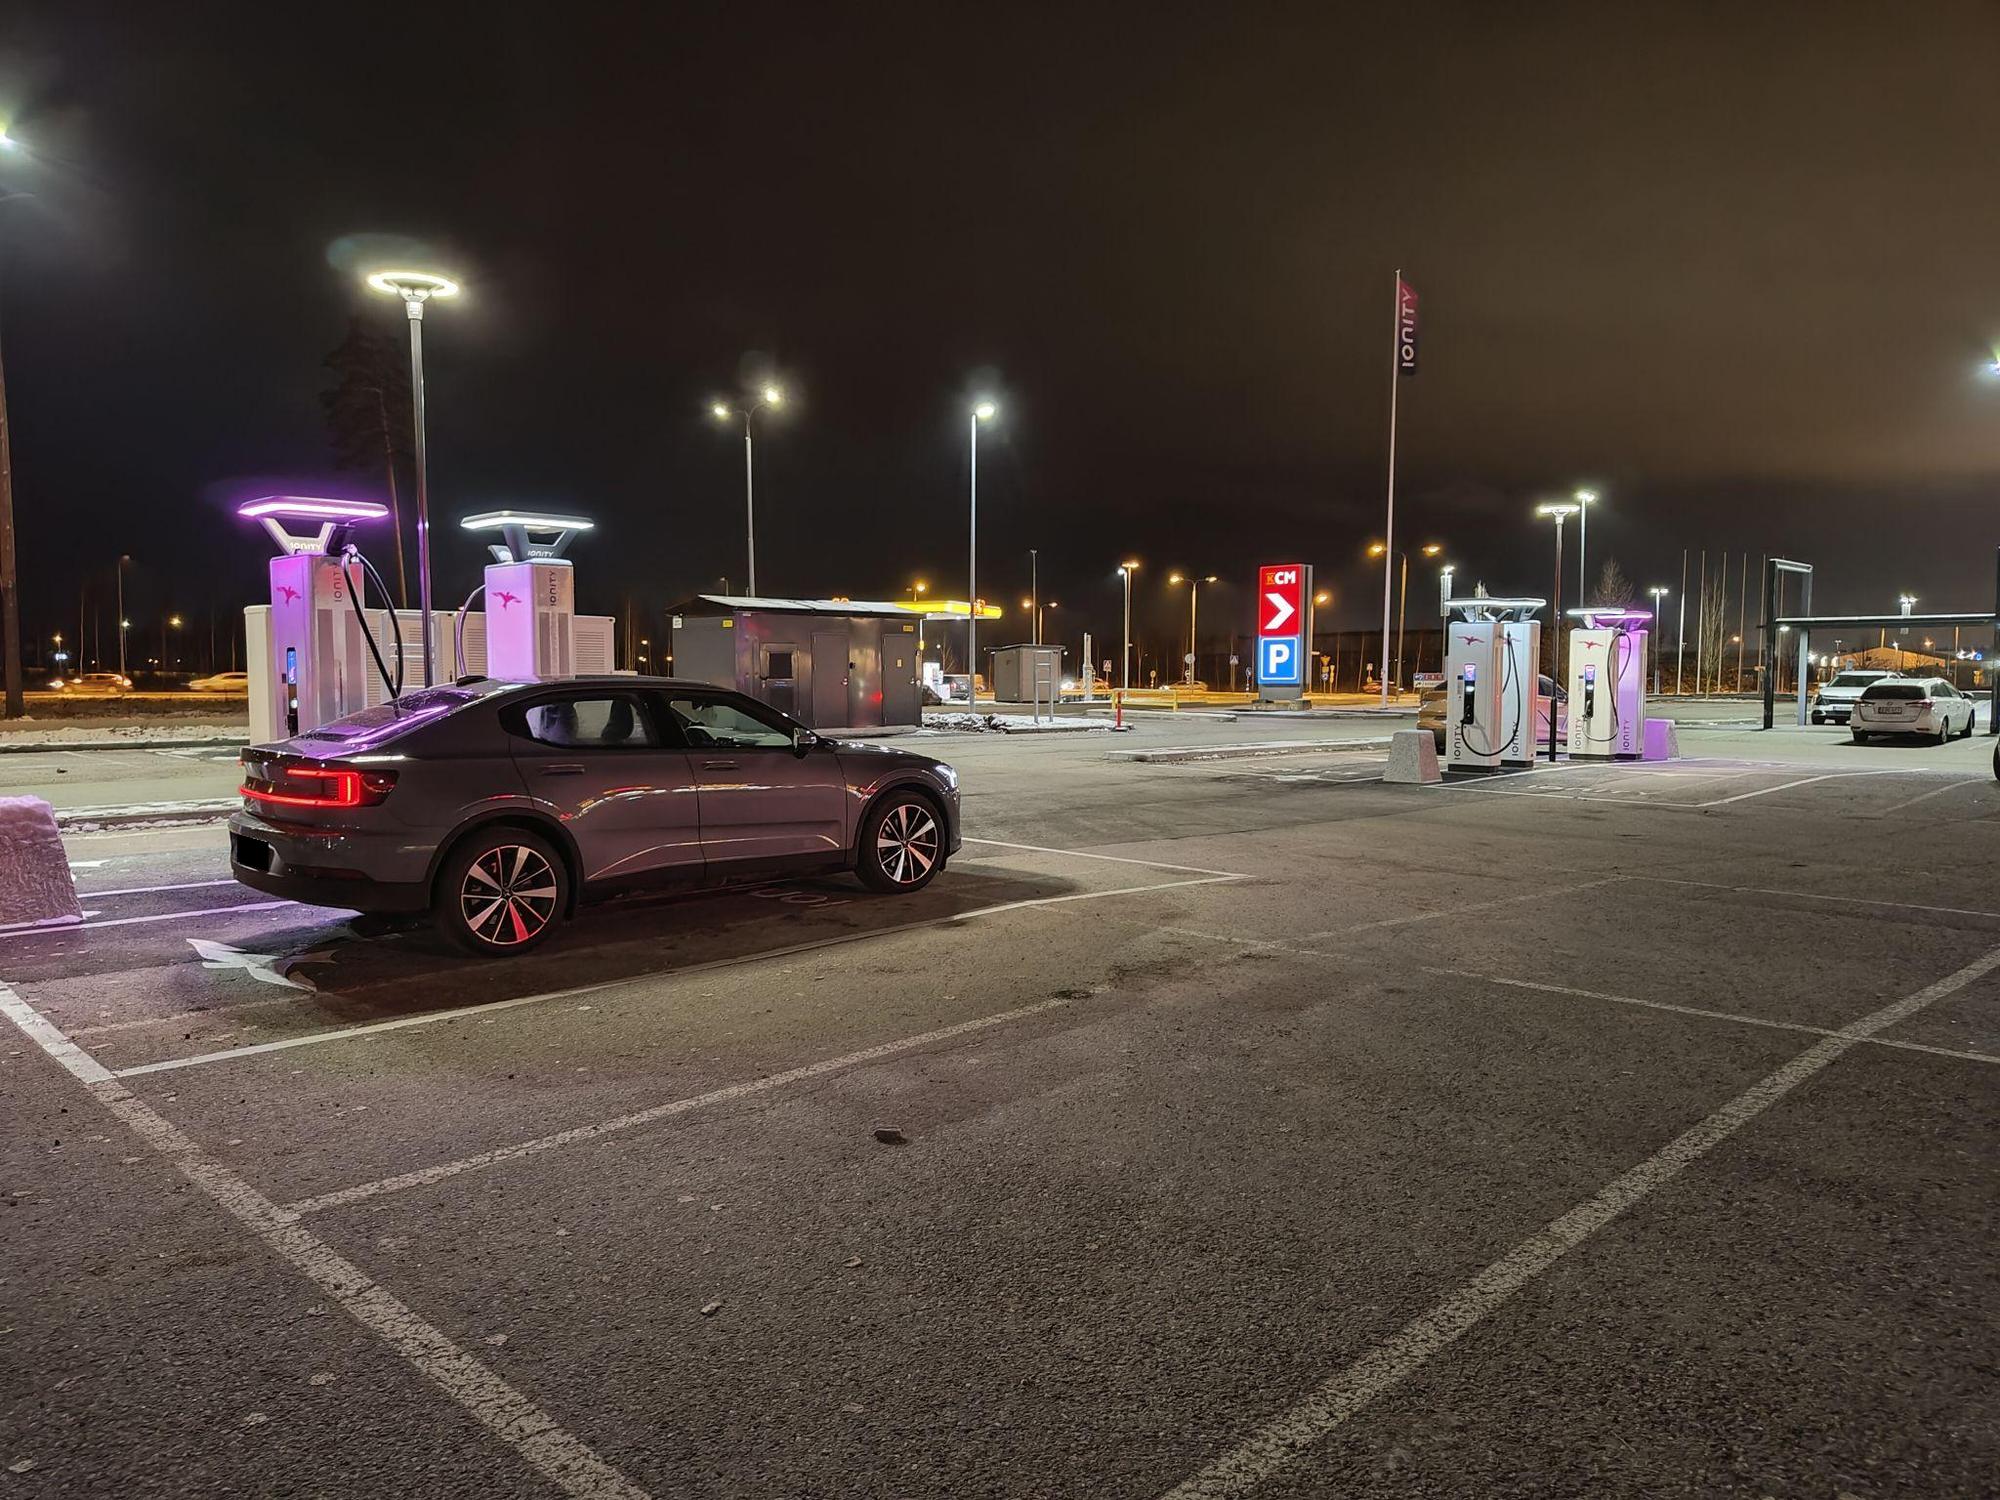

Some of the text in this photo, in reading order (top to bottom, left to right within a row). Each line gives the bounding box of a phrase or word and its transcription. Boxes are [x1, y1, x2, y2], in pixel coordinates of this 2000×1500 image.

[1402, 288, 1415, 367] IONITY
[527, 550, 554, 558] IONITY
[549, 570, 557, 607] IONITY
[1265, 571, 1297, 585] KCM
[1269, 643, 1290, 674] P
[1453, 724, 1462, 760] IONITY
[1574, 717, 1583, 750] IONITY
[1622, 719, 1631, 751] IONITY
